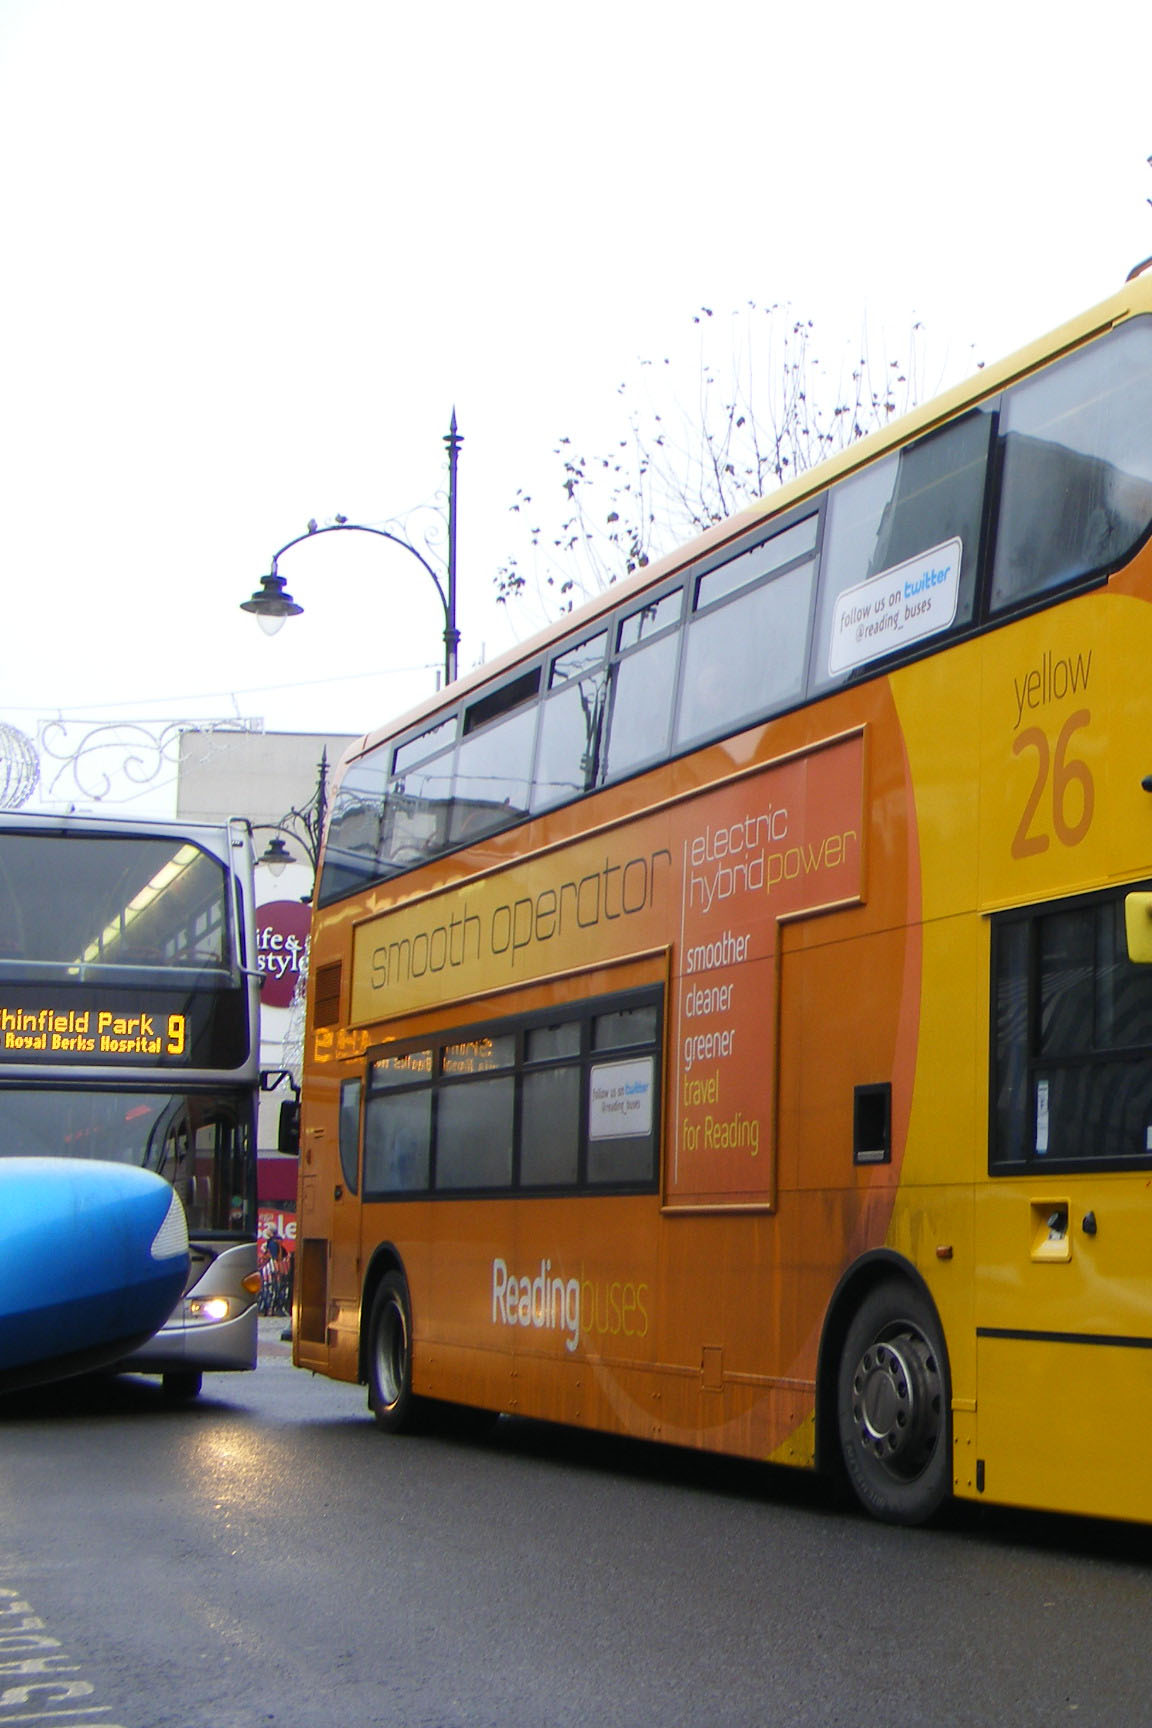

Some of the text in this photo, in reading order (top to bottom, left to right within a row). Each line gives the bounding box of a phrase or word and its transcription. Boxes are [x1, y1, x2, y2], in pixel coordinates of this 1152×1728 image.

[840, 566, 951, 632] follow us on twitter
[1013, 650, 1092, 730] yellow
[1011, 708, 1095, 861] 26
[691, 803, 788, 867] electric
[370, 849, 672, 990] smooth operator
[686, 929, 751, 974] smoother
[0, 1008, 154, 1036] hinfield Park
[685, 984, 734, 1018] cleaner
[5, 1032, 162, 1054] Royal Berks Hospital
[167, 1014, 186, 1055] 9
[684, 1029, 735, 1072] greener
[683, 1069, 720, 1106] travel
[682, 1112, 760, 1157] for Reading
